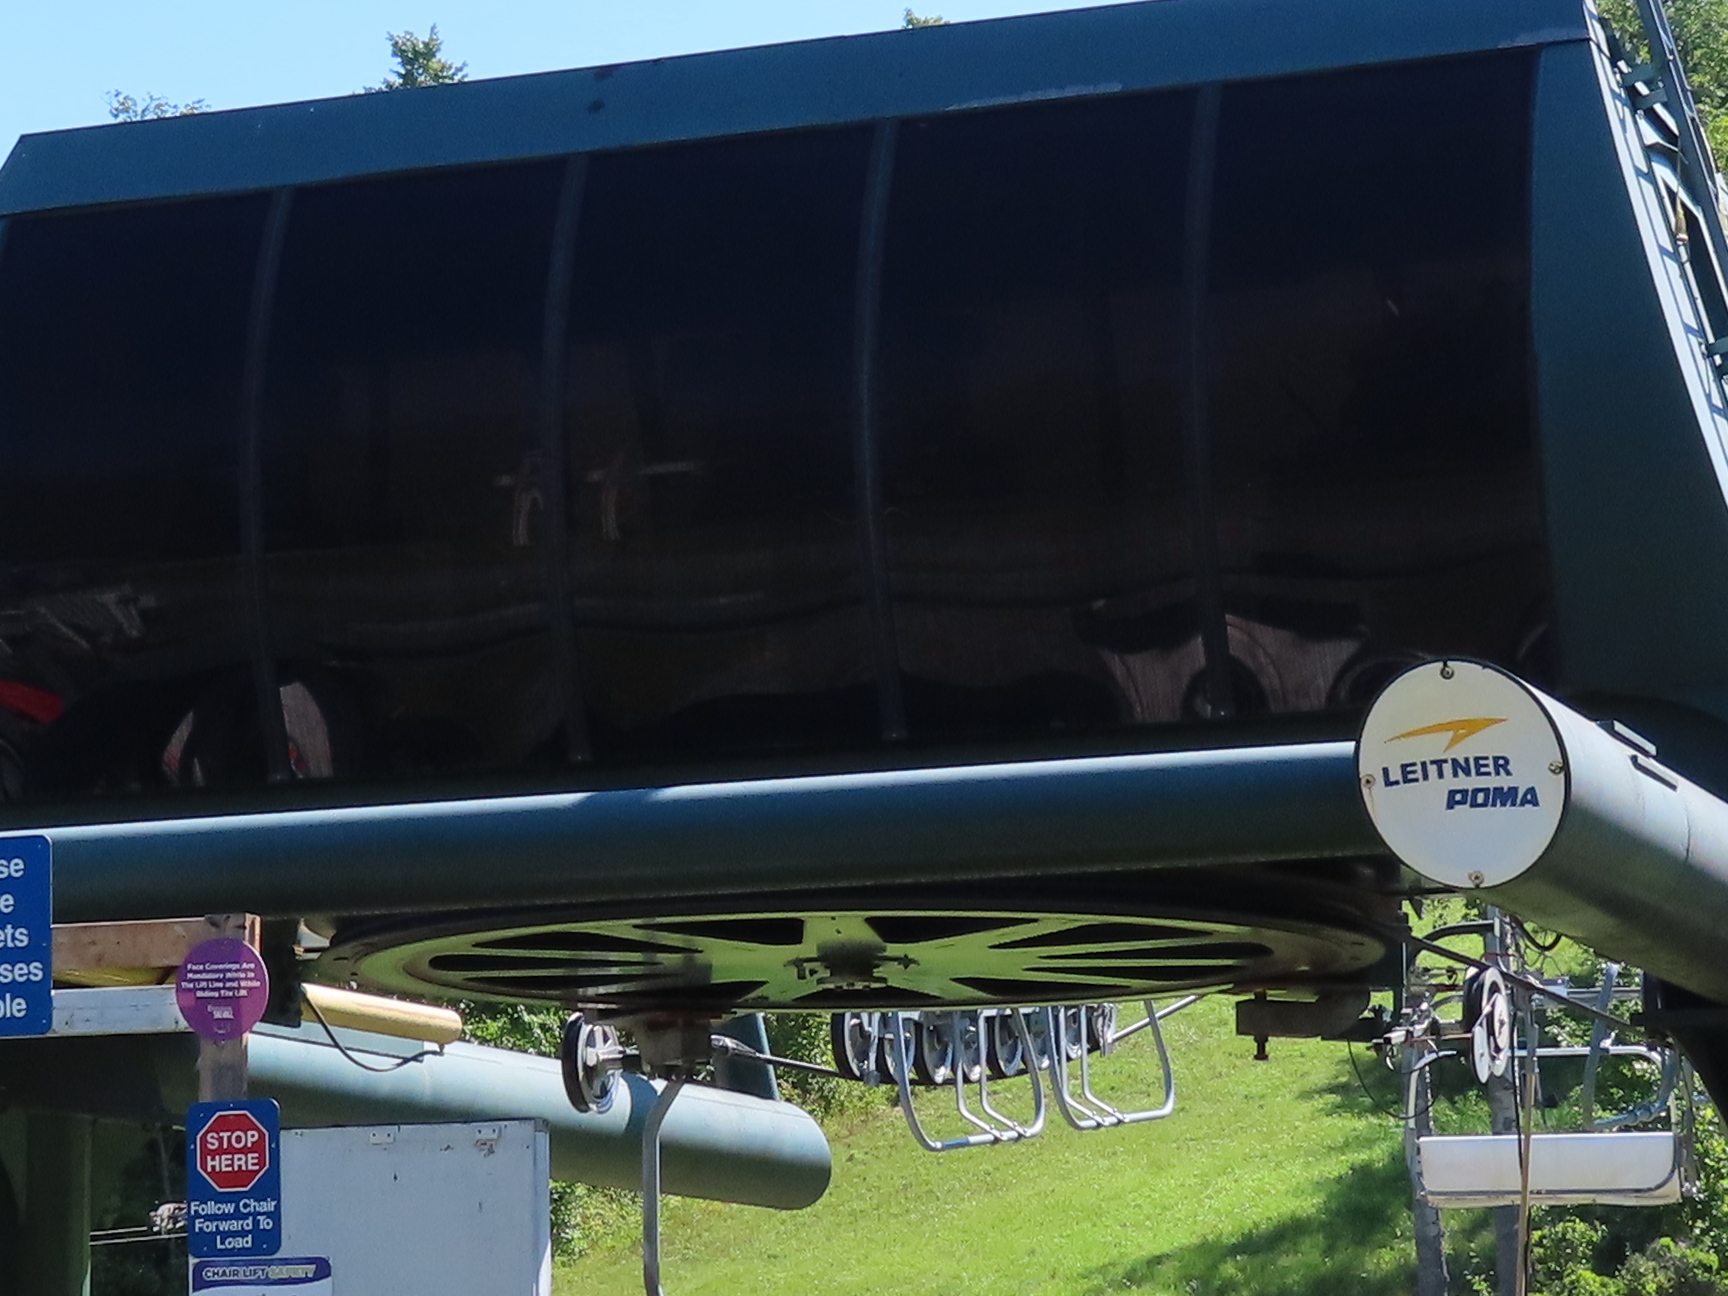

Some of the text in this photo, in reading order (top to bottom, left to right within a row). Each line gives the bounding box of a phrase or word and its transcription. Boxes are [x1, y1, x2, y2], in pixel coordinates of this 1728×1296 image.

[1381, 755, 1514, 788] LEITNER
[1445, 786, 1540, 810] POMA
[206, 1130, 259, 1150] STOP
[206, 1153, 260, 1173] HERE
[190, 1198, 277, 1216] Follow Chair
[194, 1215, 273, 1233] Forward To
[216, 1233, 253, 1250] Load
[202, 1266, 239, 1280] CHAIR
[242, 1265, 268, 1279] LIFT
